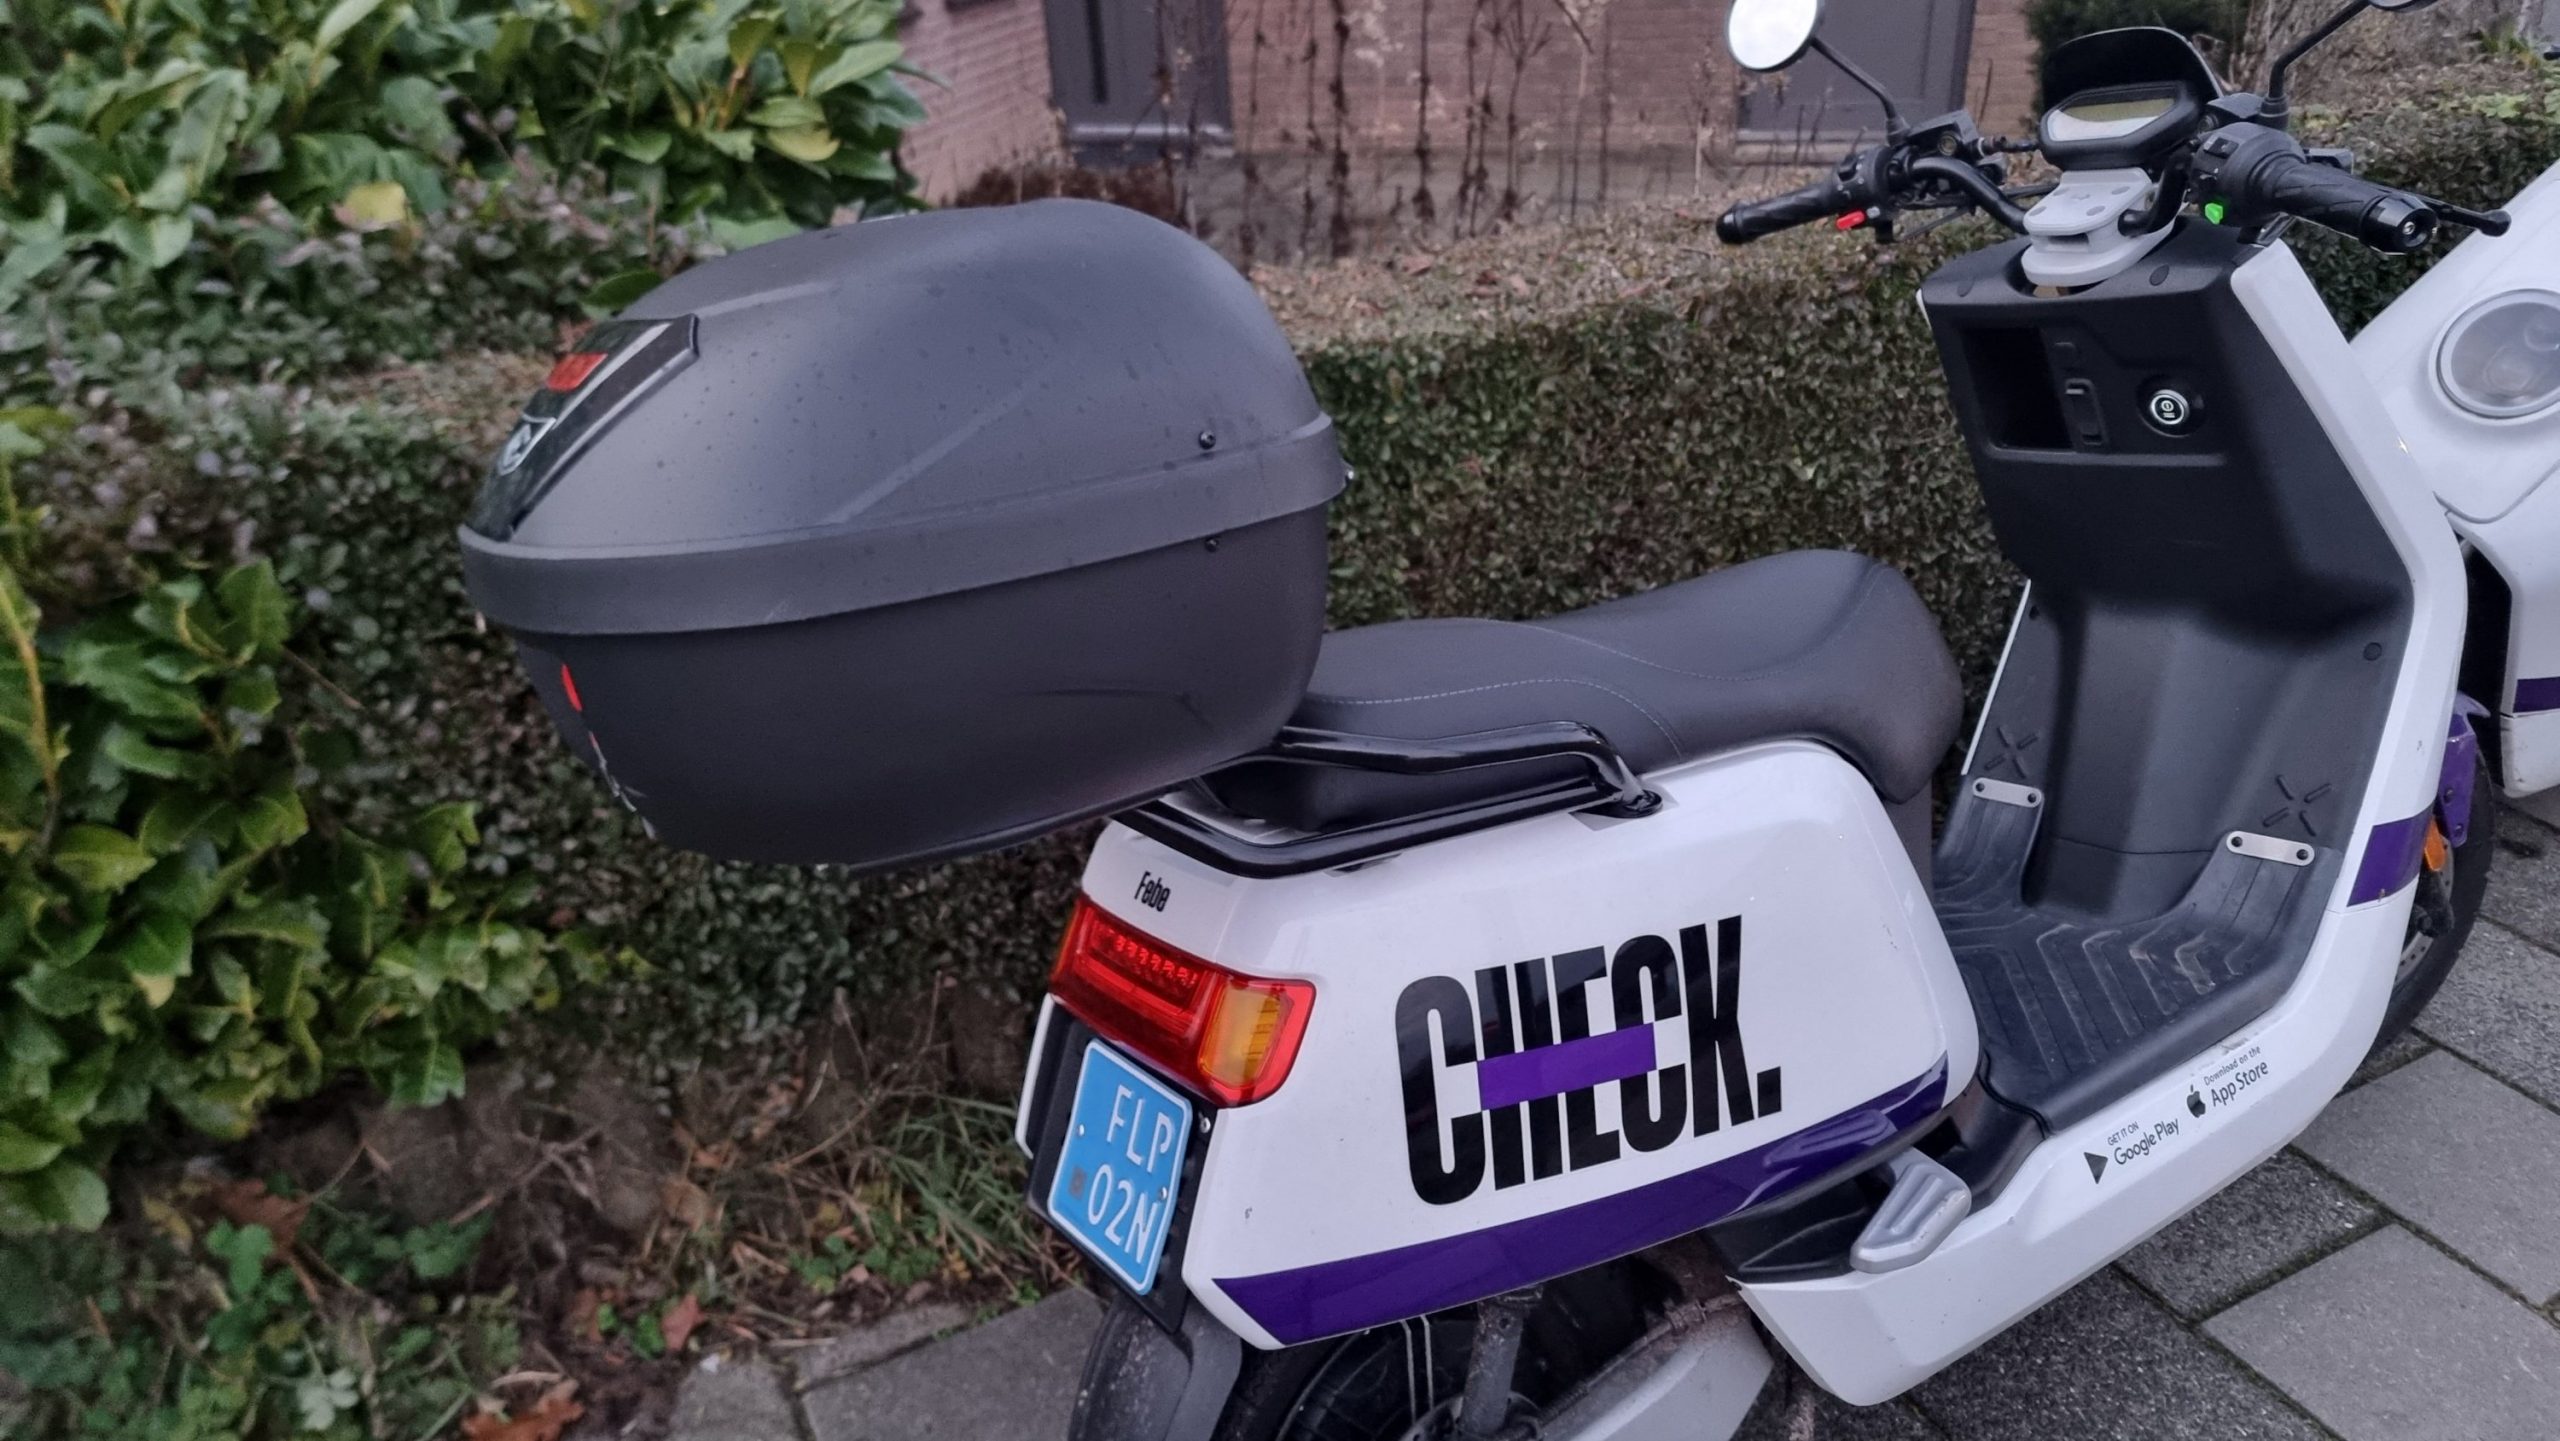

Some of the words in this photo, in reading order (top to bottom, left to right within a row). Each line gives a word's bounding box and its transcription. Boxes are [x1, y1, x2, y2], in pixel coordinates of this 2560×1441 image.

[1134, 870, 1171, 912] Febe
[1395, 914, 1782, 1206] CHECK.
[2203, 1058, 2239, 1086] Download
[2239, 1054, 2249, 1064] on
[2248, 1046, 2261, 1058] the
[2211, 1082, 2237, 1107] App
[2235, 1062, 2269, 1090] Store
[1106, 1085, 1172, 1174] FLP
[2107, 1131, 2121, 1146] GET
[2120, 1127, 2128, 1138] IT
[2127, 1120, 2140, 1134] ON
[2114, 1132, 2157, 1165] Google
[2153, 1118, 2179, 1141] Play
[1087, 1164, 1160, 1265] 02N
